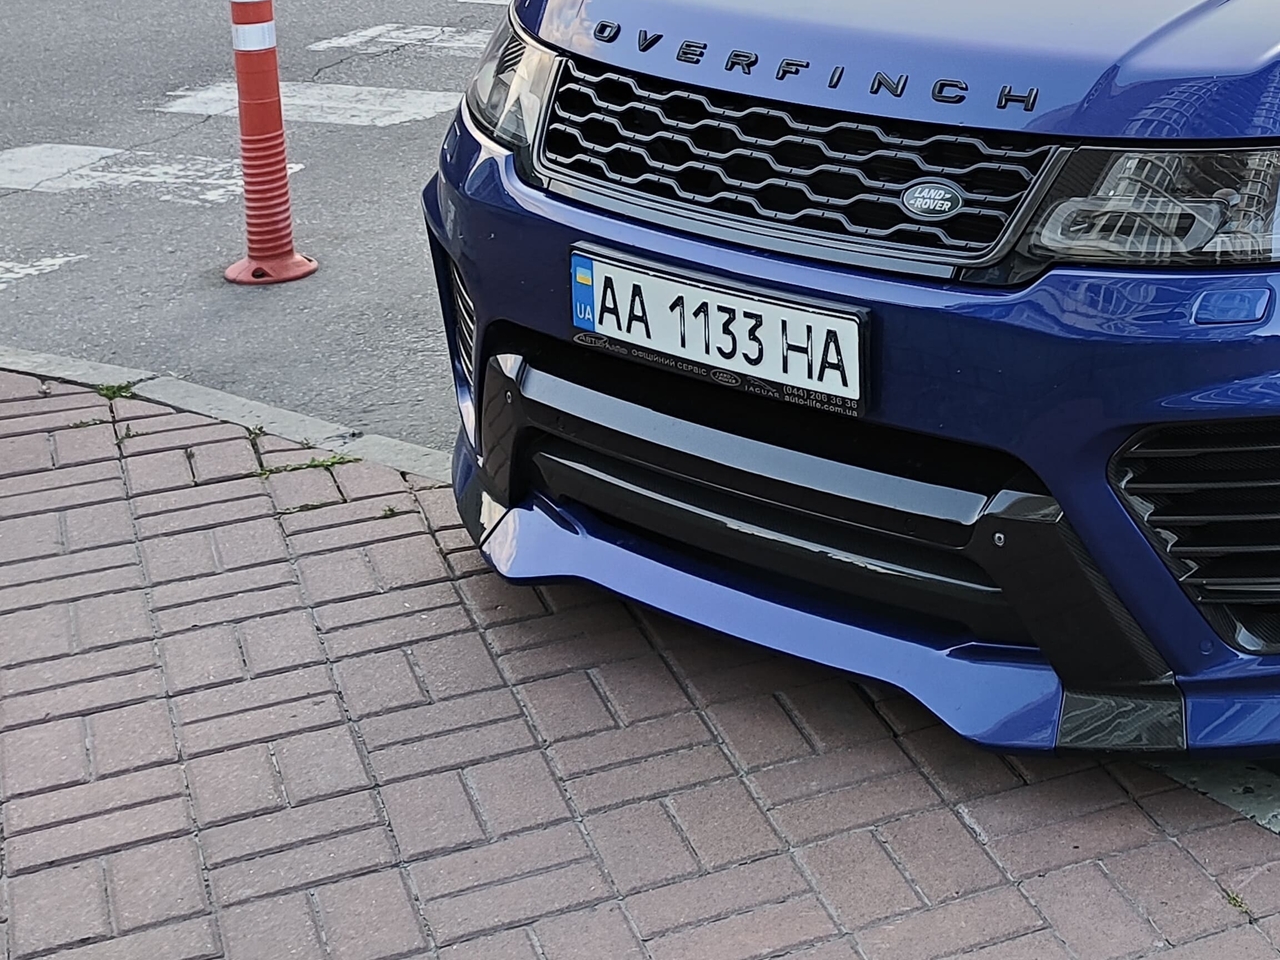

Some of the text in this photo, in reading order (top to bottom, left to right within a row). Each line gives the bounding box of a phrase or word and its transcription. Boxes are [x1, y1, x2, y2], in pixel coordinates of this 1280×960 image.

[593, 19, 1039, 112] OVERFINCH
[914, 187, 945, 199] LAND
[914, 198, 951, 211] ROVER
[577, 305, 593, 322] UA
[598, 275, 848, 387] AA 1133 HA
[677, 362, 707, 375] СЕРВІС
[745, 385, 780, 398] JAGUAR
[783, 385, 858, 409] (044) 206 36 36
[784, 395, 858, 417] auto-life.com.ua
